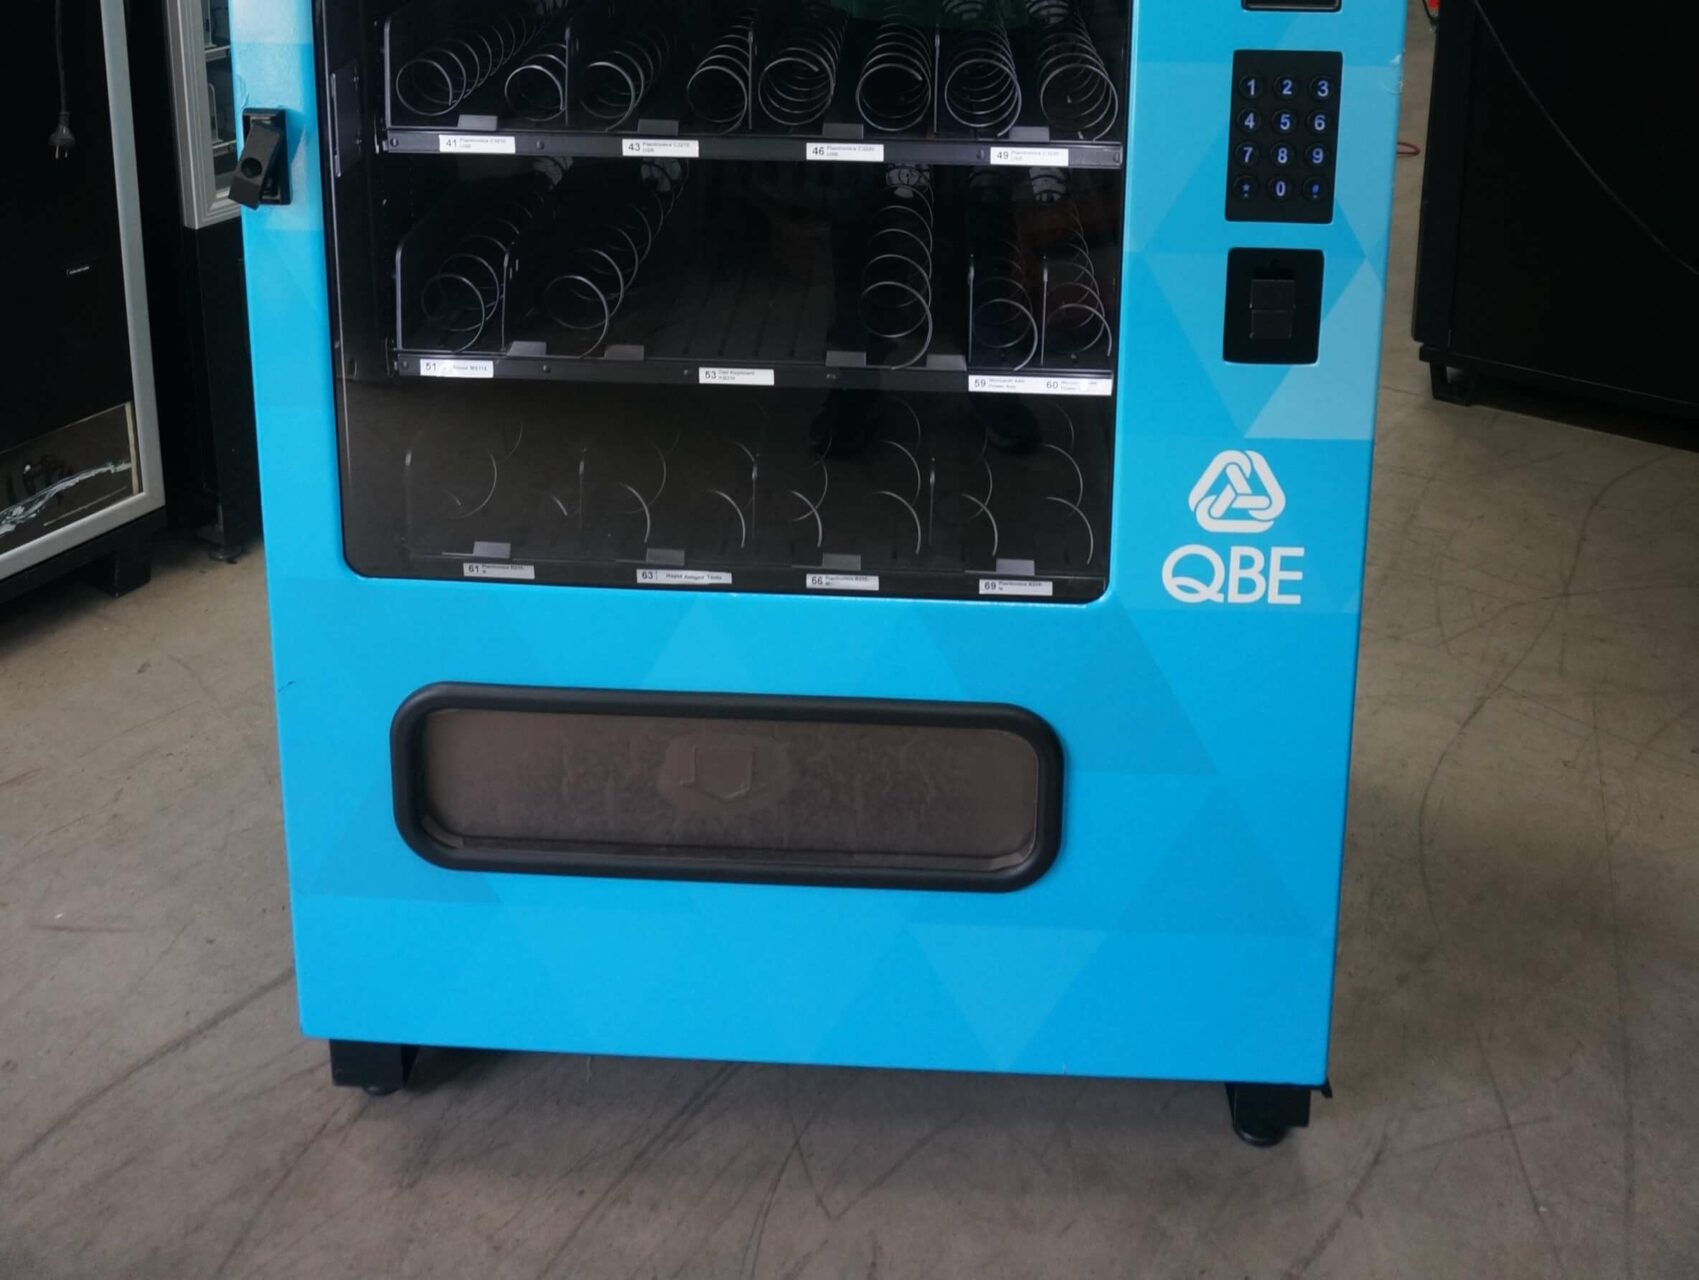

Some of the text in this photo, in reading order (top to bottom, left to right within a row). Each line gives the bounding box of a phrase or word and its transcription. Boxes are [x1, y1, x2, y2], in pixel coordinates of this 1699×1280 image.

[1247, 79, 1329, 97] 1 2 3
[1244, 112, 1326, 131] 4 5 6
[446, 138, 457, 148] 41
[628, 142, 640, 151] 43
[812, 146, 824, 156] 46
[996, 151, 1009, 160] 49
[1243, 147, 1324, 164] 7 8 9
[1275, 181, 1286, 197] 0
[425, 361, 437, 371] 51
[705, 370, 717, 380] 53
[974, 378, 986, 388] 59
[1046, 380, 1059, 390] 60
[468, 564, 479, 573] 61
[642, 571, 653, 580] 63
[1161, 543, 1305, 605] QBE
[811, 575, 823, 585] 66
[984, 581, 996, 590] 69
